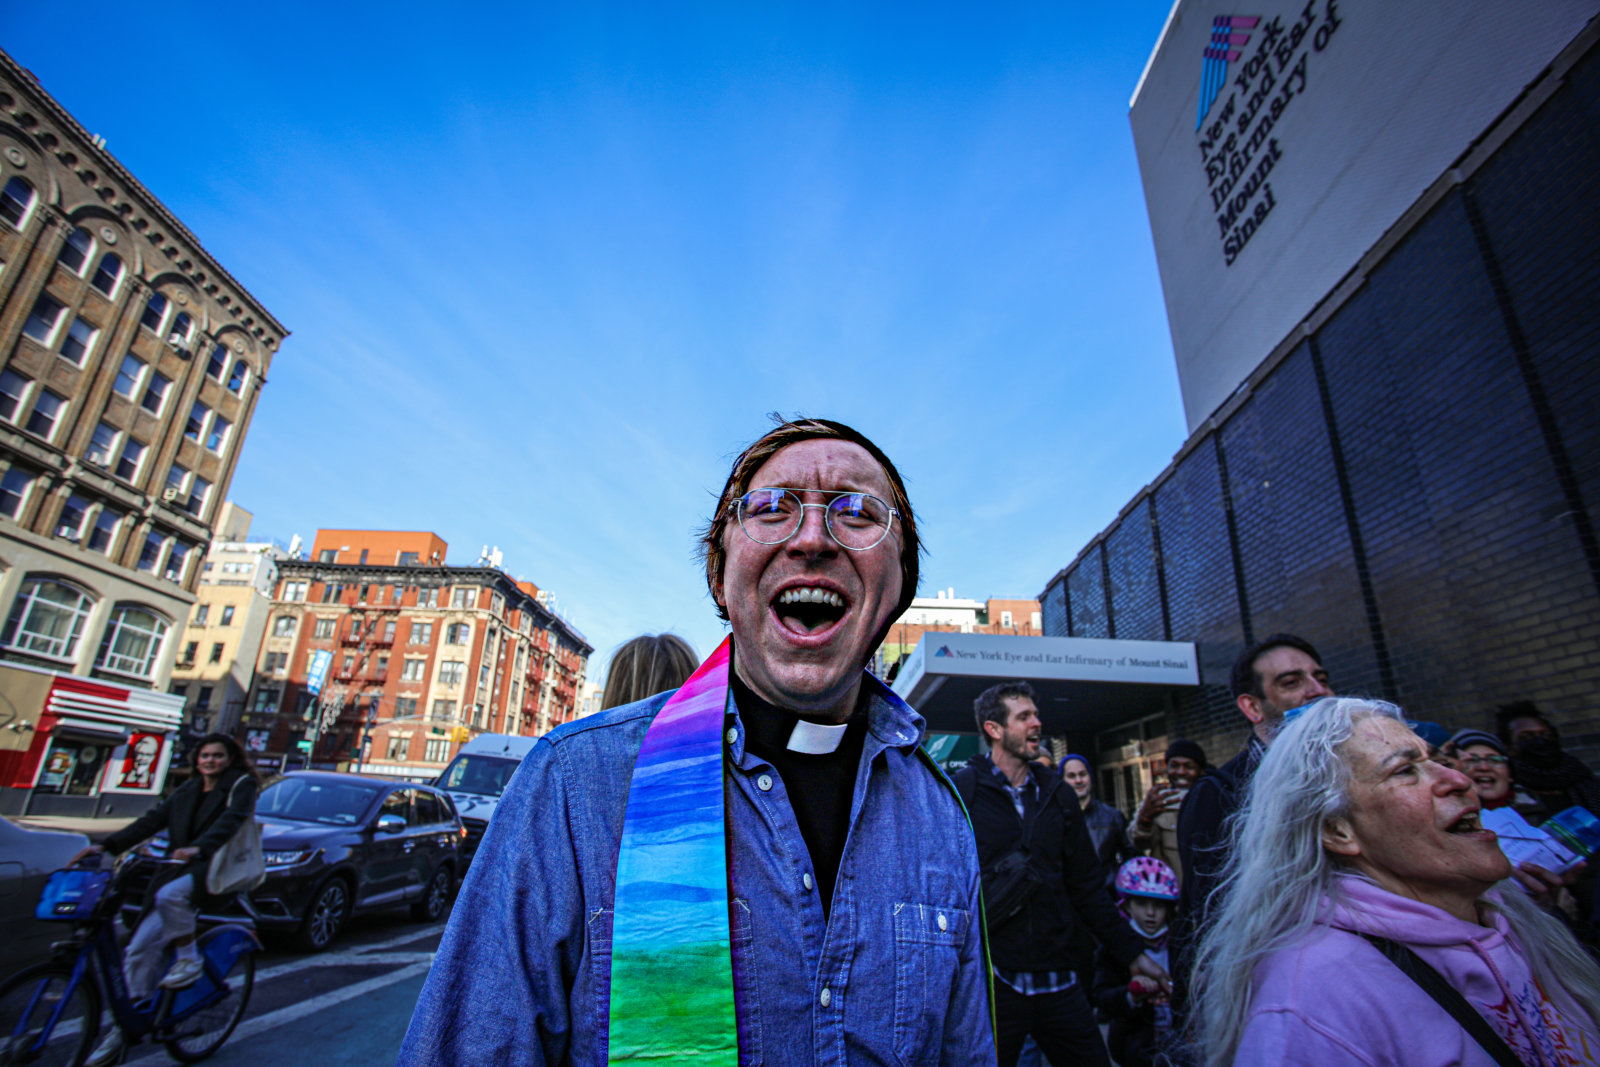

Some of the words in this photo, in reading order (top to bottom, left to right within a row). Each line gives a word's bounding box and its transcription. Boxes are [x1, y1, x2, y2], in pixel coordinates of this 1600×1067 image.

[1199, 93, 1236, 163] New
[1234, 14, 1285, 96] York
[1204, 132, 1239, 188] Eye
[1237, 62, 1277, 136] and
[1273, 0, 1318, 74] Ear
[1209, 51, 1309, 214] Infirmary
[1312, 0, 1343, 53] of
[1217, 137, 1283, 240] Mount
[1223, 183, 1278, 268] Sinai
[956, 649, 978, 660] New
[979, 650, 1002, 661] York
[1004, 651, 1022, 664] Eye
[1024, 653, 1043, 663] and
[1045, 654, 1063, 664] Ear
[1064, 654, 1114, 668] Infirmary
[1116, 655, 1128, 667] of
[1129, 658, 1161, 668] Mount
[1162, 659, 1189, 669] Sinai
